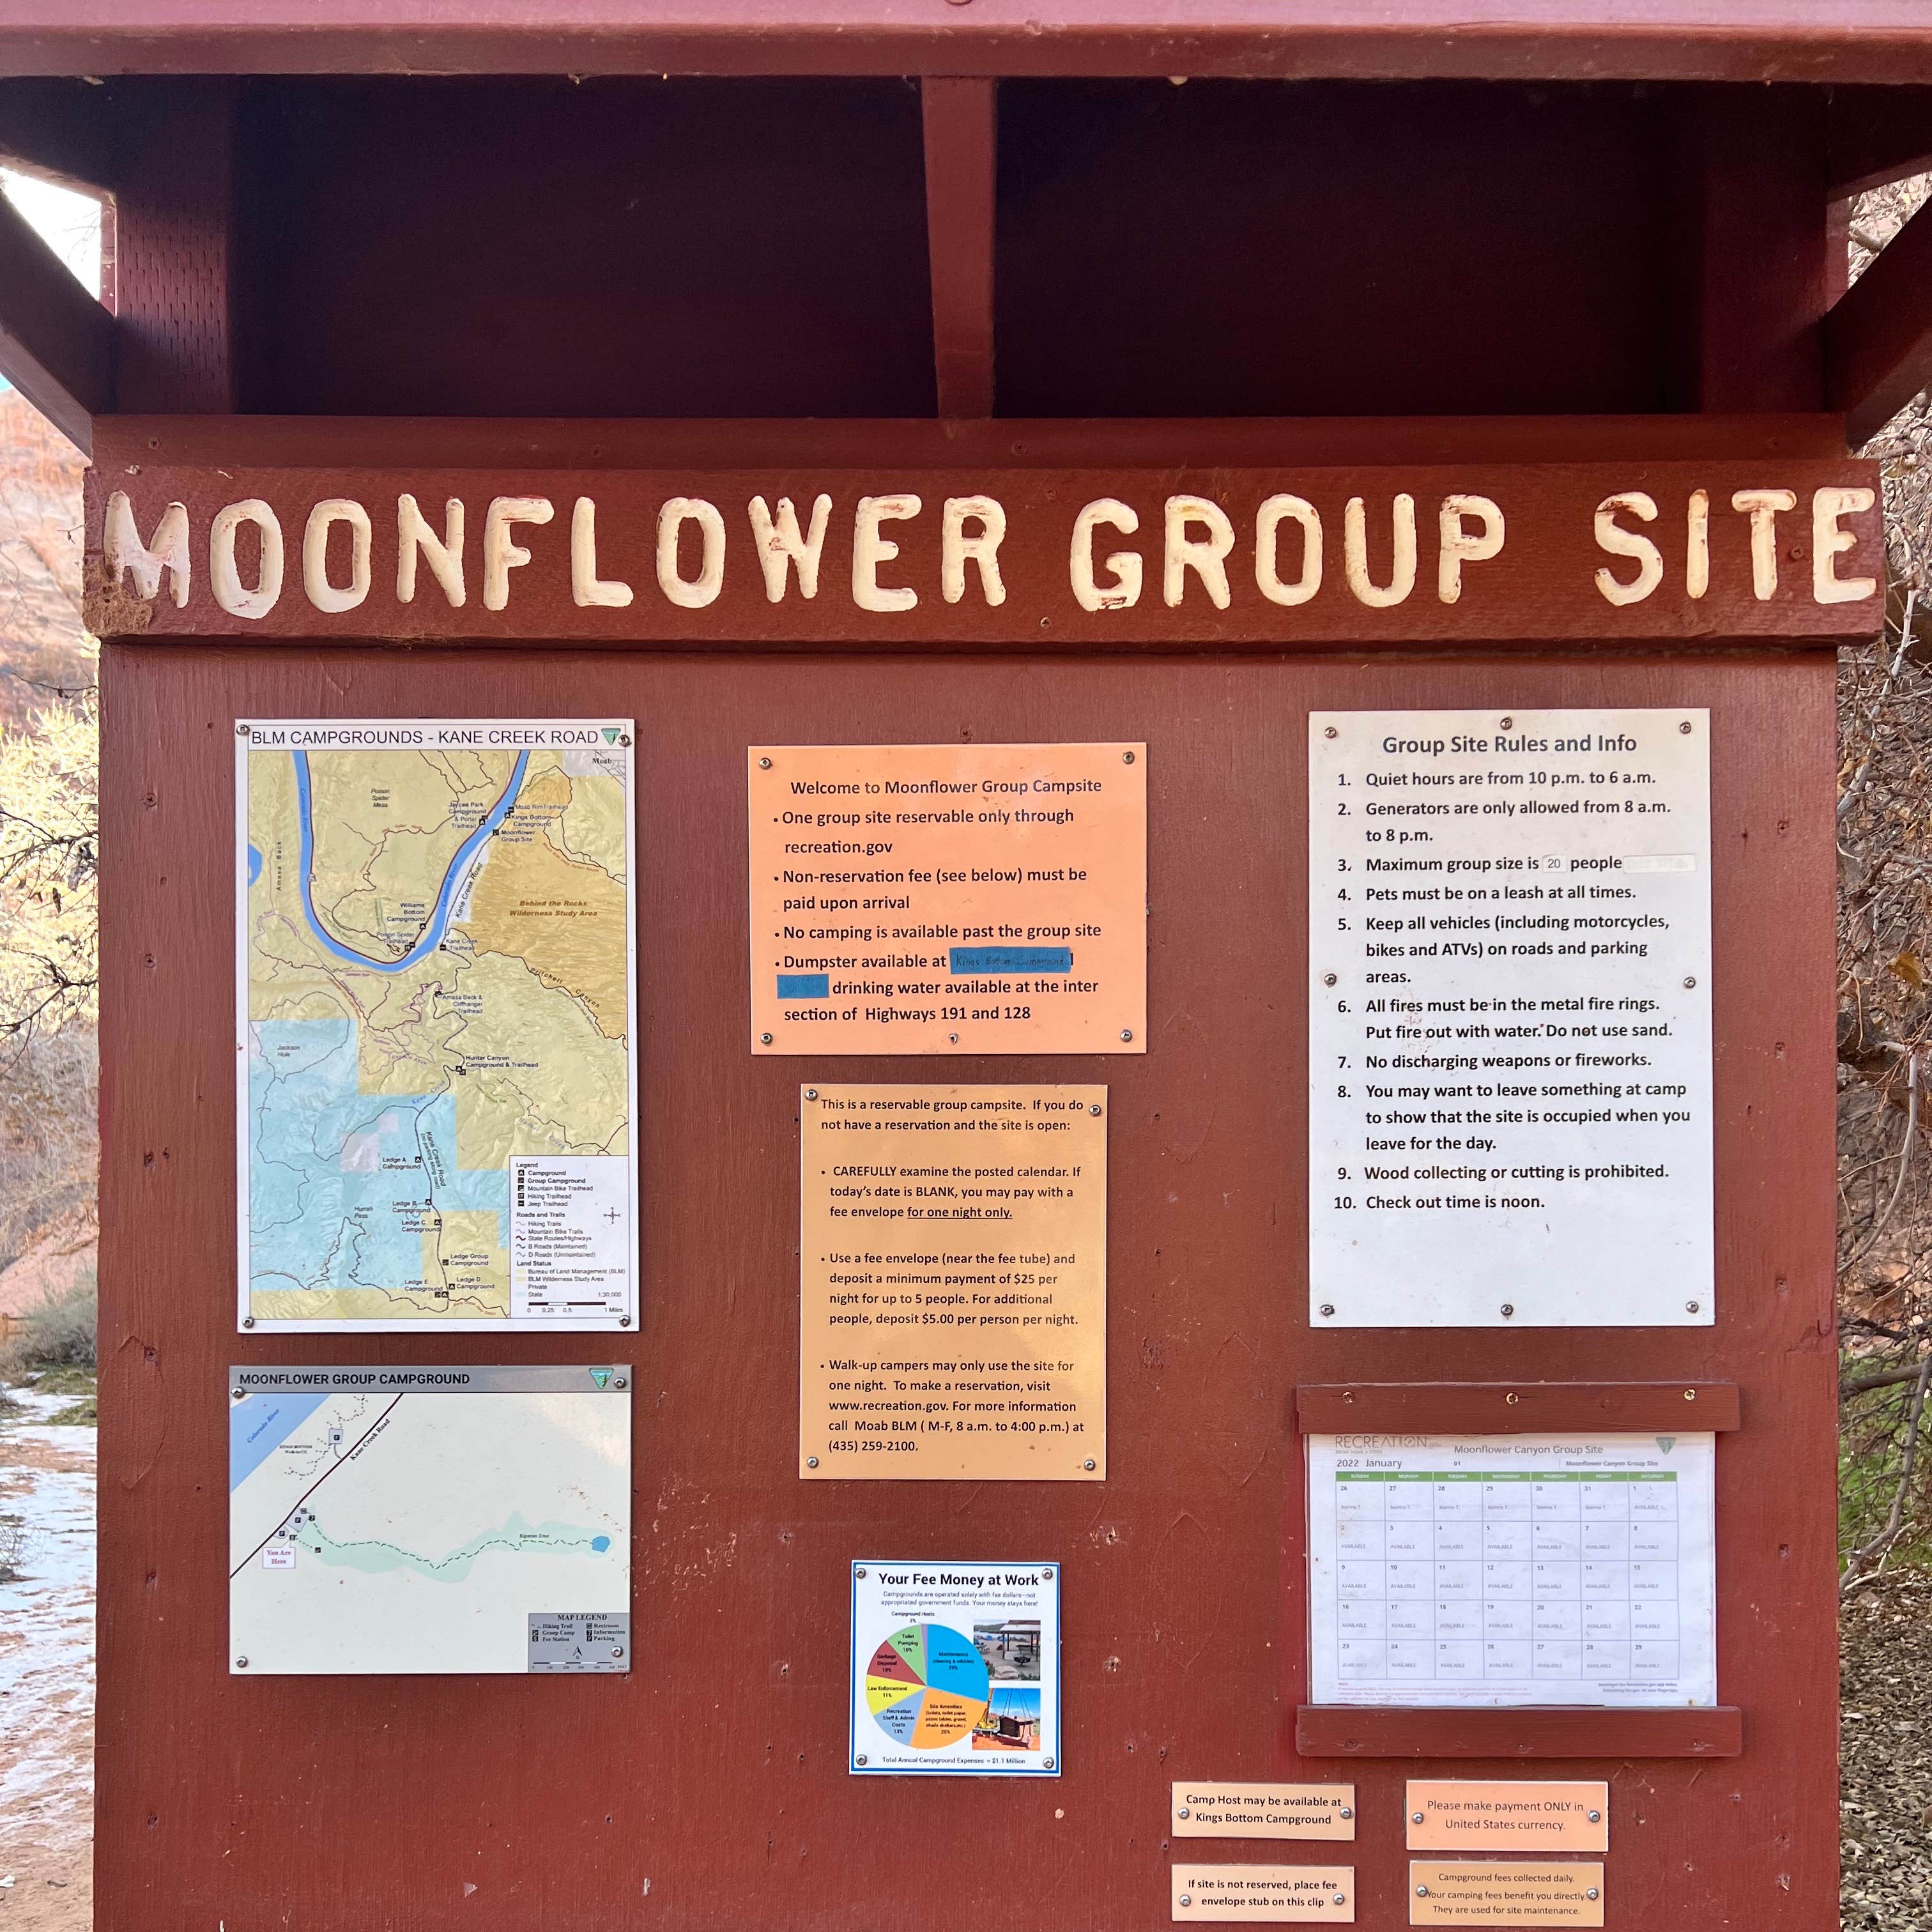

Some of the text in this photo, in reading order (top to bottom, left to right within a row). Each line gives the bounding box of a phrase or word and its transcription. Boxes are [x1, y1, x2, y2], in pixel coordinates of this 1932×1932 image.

[104, 487, 1877, 618] MOONFLOWER GROUP SITE
[252, 731, 285, 744] BLM
[291, 731, 423, 744] CAMPGROUNDS
[439, 731, 483, 744] KANE
[489, 731, 546, 744] CREEK
[551, 731, 598, 744] ROAD
[1383, 733, 1637, 756] Group Site Rules and Info
[790, 779, 1101, 795] Welcome to Moonflower Group Campsite
[785, 840, 893, 856] recreation.gov
[1338, 855, 1622, 873] 3. Maximum group size is 20 people
[456, 863, 483, 918] Kane Creek Road
[785, 954, 947, 971] Dumpster available at
[1338, 1053, 1651, 1071] 7. No discharging weapons or fireworks.
[833, 1166, 1081, 1179] CAREFULLY examine the posted calendar. If
[1335, 1195, 1545, 1209] 10. Check out time is noon.
[240, 1374, 470, 1384] MOONFLOWER GROUP CAMPGROUND
[829, 1400, 949, 1413] www.recreation.gov.
[953, 1401, 971, 1411] For
[1008, 1400, 1076, 1411] information
[349, 1418, 390, 1460] Kane Creek Road
[829, 1440, 918, 1453] (435) 259-2100.
[1453, 1444, 1604, 1456] Moonflower Canyon Group Site
[1366, 1459, 1402, 1469] January
[878, 1573, 1039, 1588] Your Fee Money at Work
[1186, 1795, 1342, 1807] Camp Host may be available at
[1427, 1800, 1583, 1813] Please make payment ONLY in
[1196, 1813, 1331, 1825] Kings Bottom Campground
[1446, 1820, 1565, 1832] United States currency.
[1439, 1873, 1574, 1884] Campground fees collected daily.
